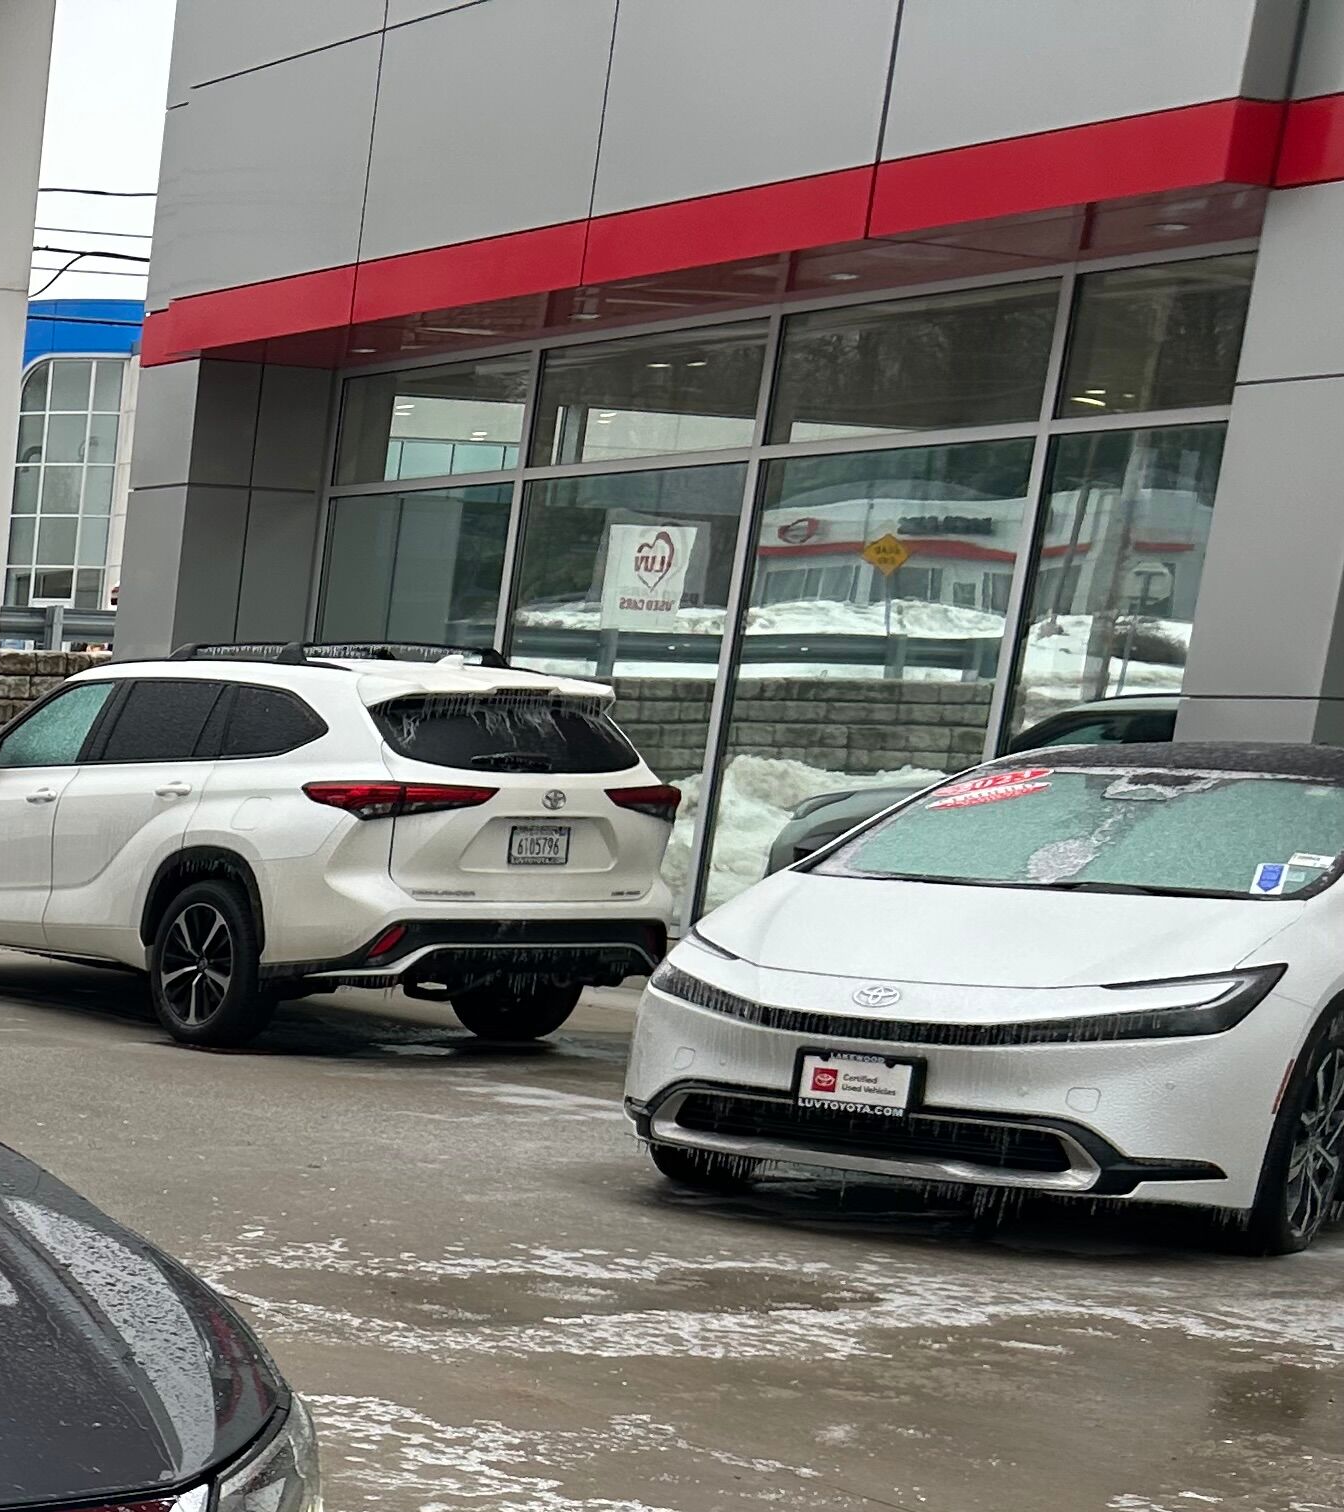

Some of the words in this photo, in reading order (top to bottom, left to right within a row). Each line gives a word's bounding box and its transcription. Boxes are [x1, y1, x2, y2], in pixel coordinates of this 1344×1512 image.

[831, 1052, 886, 1064] LAKEWOOD
[842, 1073, 878, 1085] Certified
[841, 1083, 862, 1093] Used
[863, 1085, 896, 1096] Vehicles
[798, 1098, 904, 1116] LUVTOYOTA.COM
